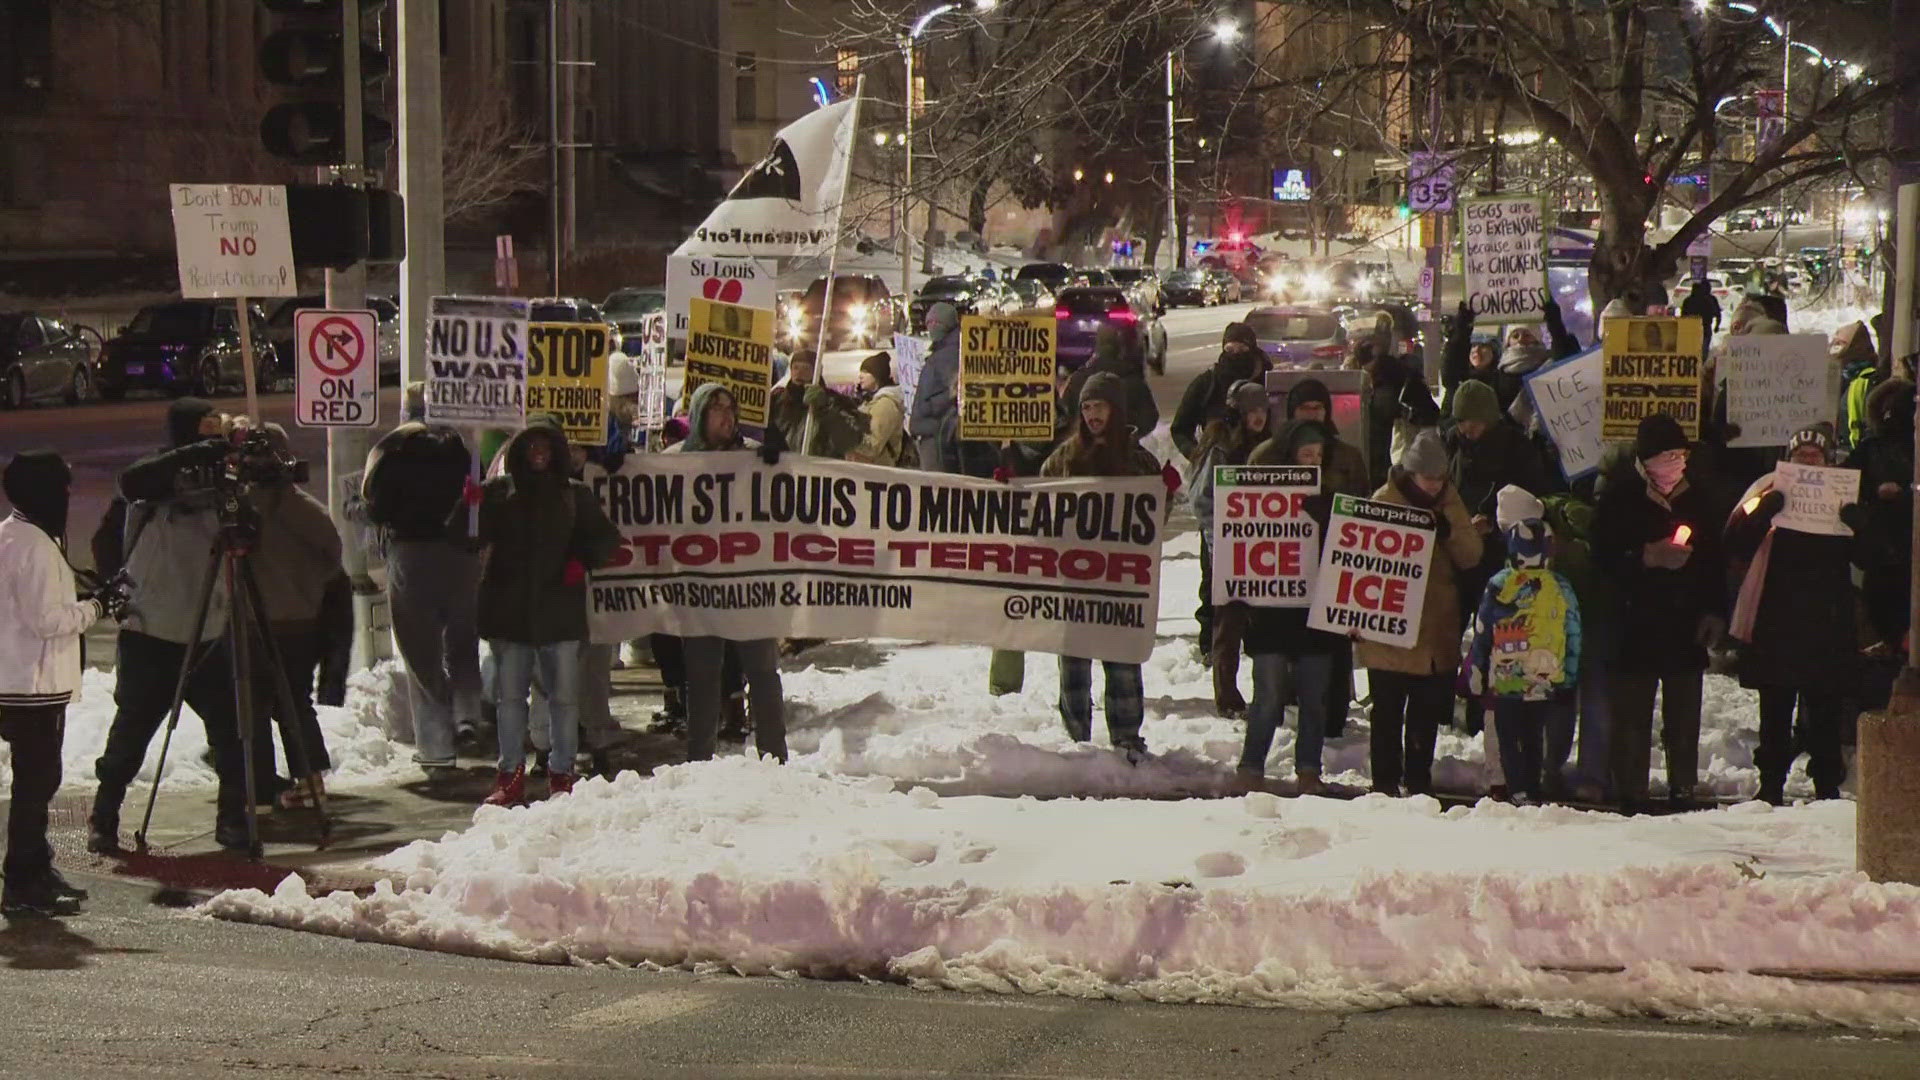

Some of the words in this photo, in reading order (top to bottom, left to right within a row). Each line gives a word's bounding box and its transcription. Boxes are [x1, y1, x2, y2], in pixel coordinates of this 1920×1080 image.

[229, 186, 262, 206] BOW
[1416, 183, 1448, 203] 35
[1467, 203, 1502, 219] EGGS
[1509, 203, 1532, 214] are
[202, 213, 259, 235] Trump
[220, 237, 257, 256] NO
[1467, 239, 1508, 257] because
[1516, 240, 1531, 250] all
[690, 260, 709, 277] St.
[714, 261, 755, 279] Louis
[1468, 259, 1484, 274] the
[1488, 254, 1546, 274] CHICKENS
[1487, 278, 1505, 288] are
[1509, 277, 1520, 287] in
[1469, 287, 1546, 315] CONGRESS
[988, 319, 1031, 328] FROM
[432, 319, 468, 357] NO
[968, 327, 994, 350] ST.
[1000, 328, 1049, 353] LOUIS
[528, 327, 604, 377] STOP
[689, 332, 742, 361] JUSTICE
[743, 343, 769, 366] FOR
[1000, 349, 1017, 357] TO
[431, 360, 524, 379] WAR
[687, 360, 767, 385] RENEE
[965, 355, 1052, 376] MINNEAPOLIS
[1606, 355, 1665, 378] JUSTICE
[1668, 355, 1698, 378] FOR
[320, 379, 354, 399] ON
[431, 380, 523, 406] VENEZUELA
[965, 382, 1052, 399] STOP
[1546, 370, 1588, 403] ICE
[1606, 384, 1698, 397] RENEE
[528, 387, 545, 408] CE
[550, 387, 601, 409] TERROR
[311, 402, 362, 421] RED
[964, 401, 987, 423] ICE
[992, 402, 1050, 424] TERROR
[1605, 401, 1654, 420] NICOLE
[1658, 401, 1697, 421] GOOD
[1567, 446, 1585, 464] IN
[1222, 468, 1312, 484] Enterprise
[1798, 469, 1824, 482] ICE
[1791, 485, 1823, 499] COLD
[593, 473, 684, 525] FROM
[692, 472, 743, 524] ST.
[752, 471, 857, 528] LOUIS
[864, 480, 911, 531] TO
[919, 485, 1157, 545] MINNEAPOLIS
[1226, 492, 1308, 519] STOP
[1340, 498, 1430, 525] Enterprise
[1222, 522, 1313, 538] PROVIDING
[1339, 522, 1425, 558] STOP
[601, 531, 761, 568] STOP
[774, 531, 875, 566] ICE
[888, 541, 1152, 585] TERROR
[1233, 541, 1300, 576] ICE
[1331, 550, 1423, 579] PROVIDING
[1225, 580, 1307, 598] VEHICLES
[1335, 571, 1408, 613] ICE
[592, 584, 647, 613] PARTY
[649, 582, 685, 606] FOR
[688, 581, 777, 609] SOCIALISM
[780, 581, 802, 607] &
[807, 581, 912, 609] LIBERATION
[1004, 594, 1145, 628] @PSLNATIONAL
[1326, 606, 1407, 636] VEHICLES
